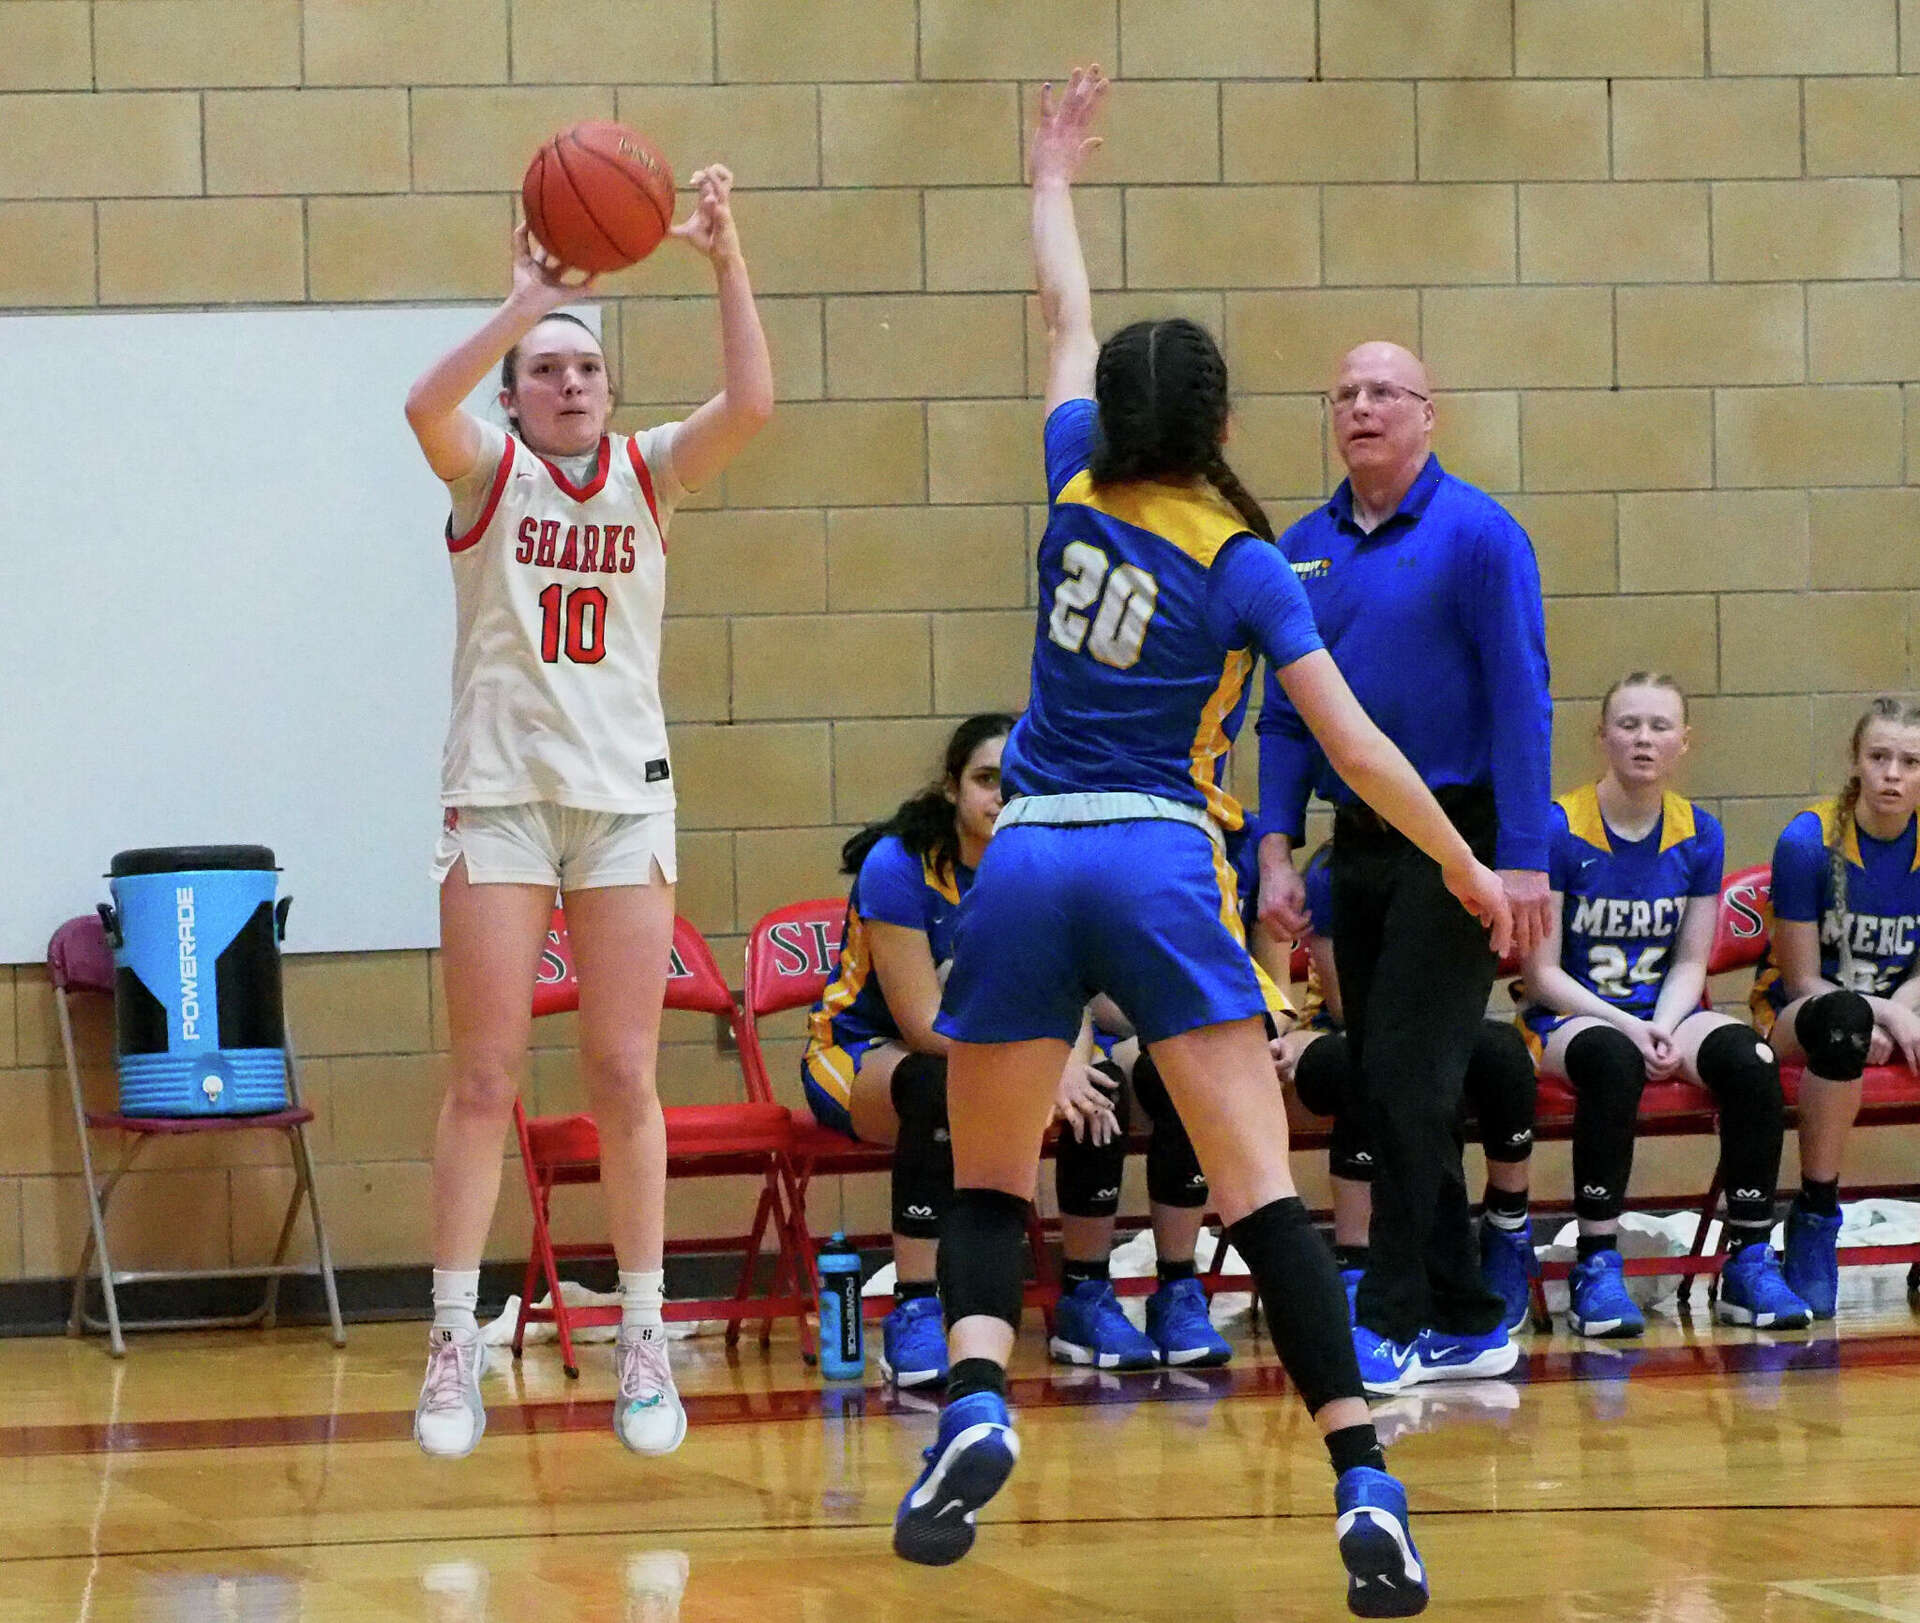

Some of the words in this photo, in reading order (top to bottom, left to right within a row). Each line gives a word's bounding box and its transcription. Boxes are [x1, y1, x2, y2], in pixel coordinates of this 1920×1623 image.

[516, 516, 636, 573] SHARKS
[539, 583, 608, 664] 10
[1049, 540, 1159, 670] 20
[176, 887, 200, 1040] POWERADE
[1821, 910, 1920, 956] MERC
[846, 1277, 857, 1355] POWERADE
